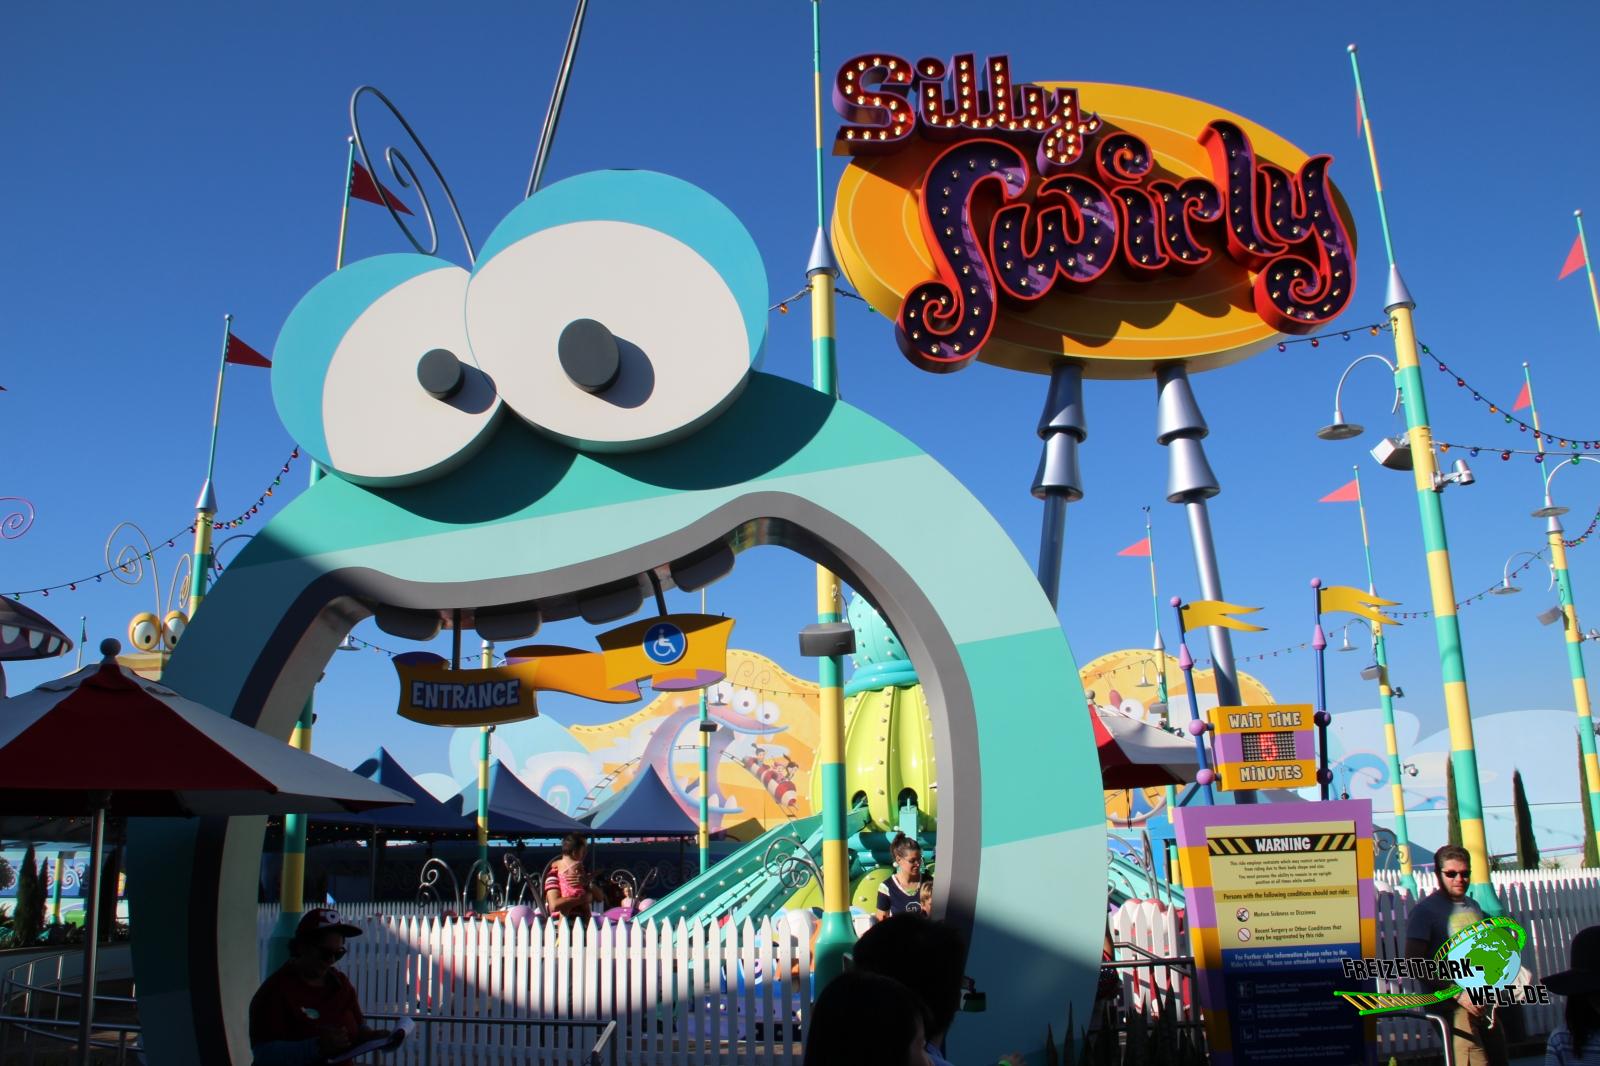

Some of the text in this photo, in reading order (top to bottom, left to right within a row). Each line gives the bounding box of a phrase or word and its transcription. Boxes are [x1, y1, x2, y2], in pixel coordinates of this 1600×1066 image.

[833, 52, 1100, 176] Silly
[895, 119, 1358, 373] Swirly
[411, 679, 520, 709] ENTRANCE
[1254, 837, 1311, 852] WARNING
